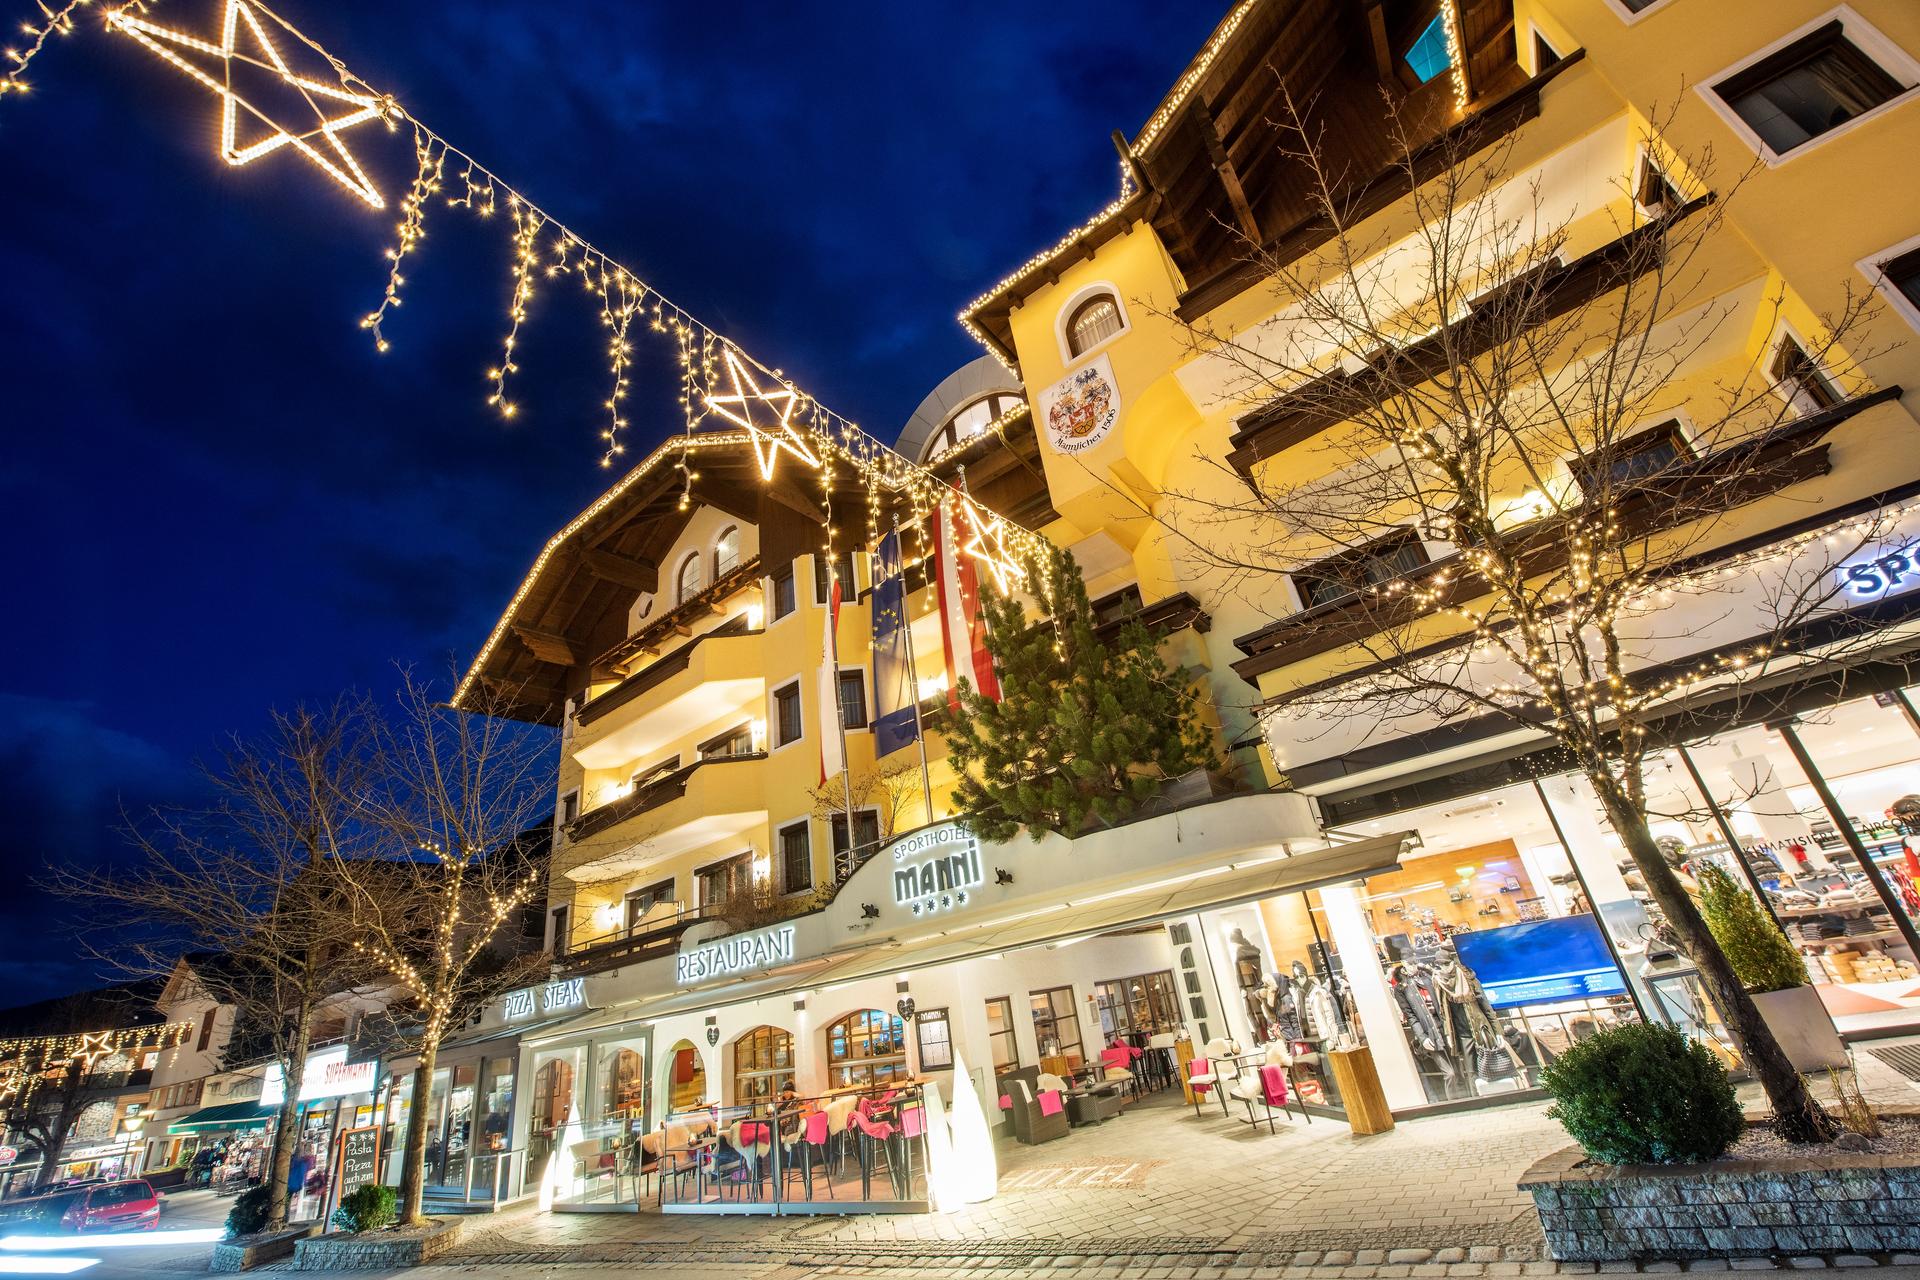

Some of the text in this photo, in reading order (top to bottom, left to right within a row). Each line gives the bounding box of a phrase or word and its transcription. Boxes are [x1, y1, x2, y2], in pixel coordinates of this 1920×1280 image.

[1847, 546, 1920, 594] SP
[894, 827, 968, 859] SPORTHOTEL
[1742, 832, 1838, 854] KLIMATISIERT
[677, 928, 793, 981] RESTAURANT
[503, 978, 583, 1018] PIZZA STEAK
[345, 1141, 373, 1156] Pasta
[344, 1158, 373, 1172] Pizza
